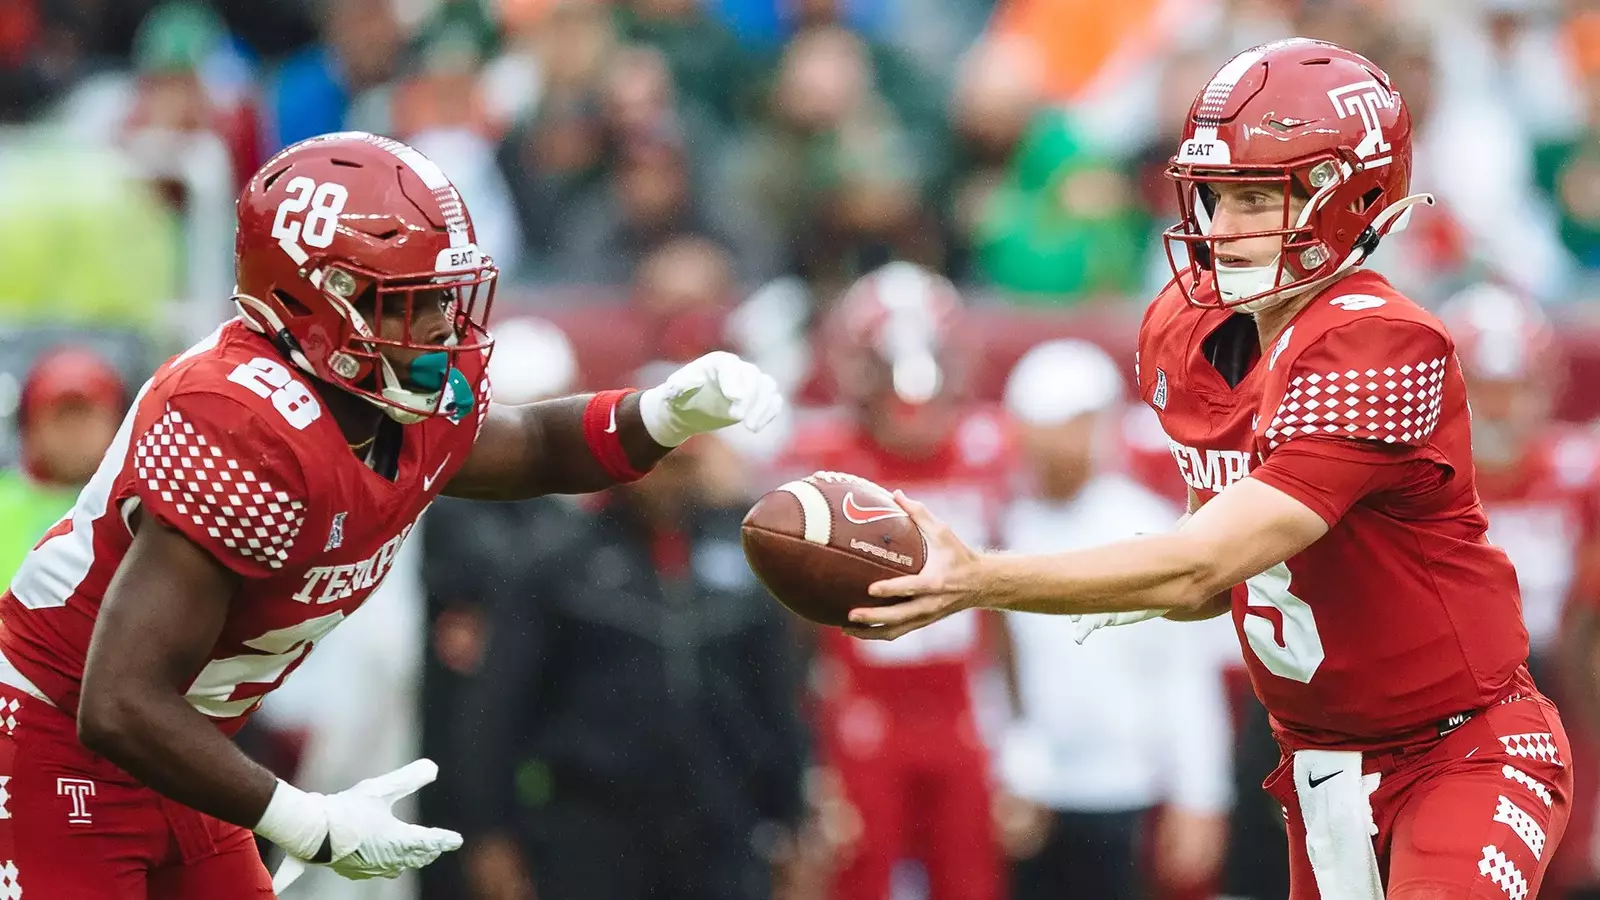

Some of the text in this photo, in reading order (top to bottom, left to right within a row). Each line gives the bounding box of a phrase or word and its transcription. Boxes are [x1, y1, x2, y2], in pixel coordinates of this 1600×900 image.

[1187, 143, 1214, 156] EAT
[271, 176, 349, 249] 28
[450, 250, 473, 266] EAT
[226, 357, 321, 431] 28
[292, 523, 412, 605] TEMP
